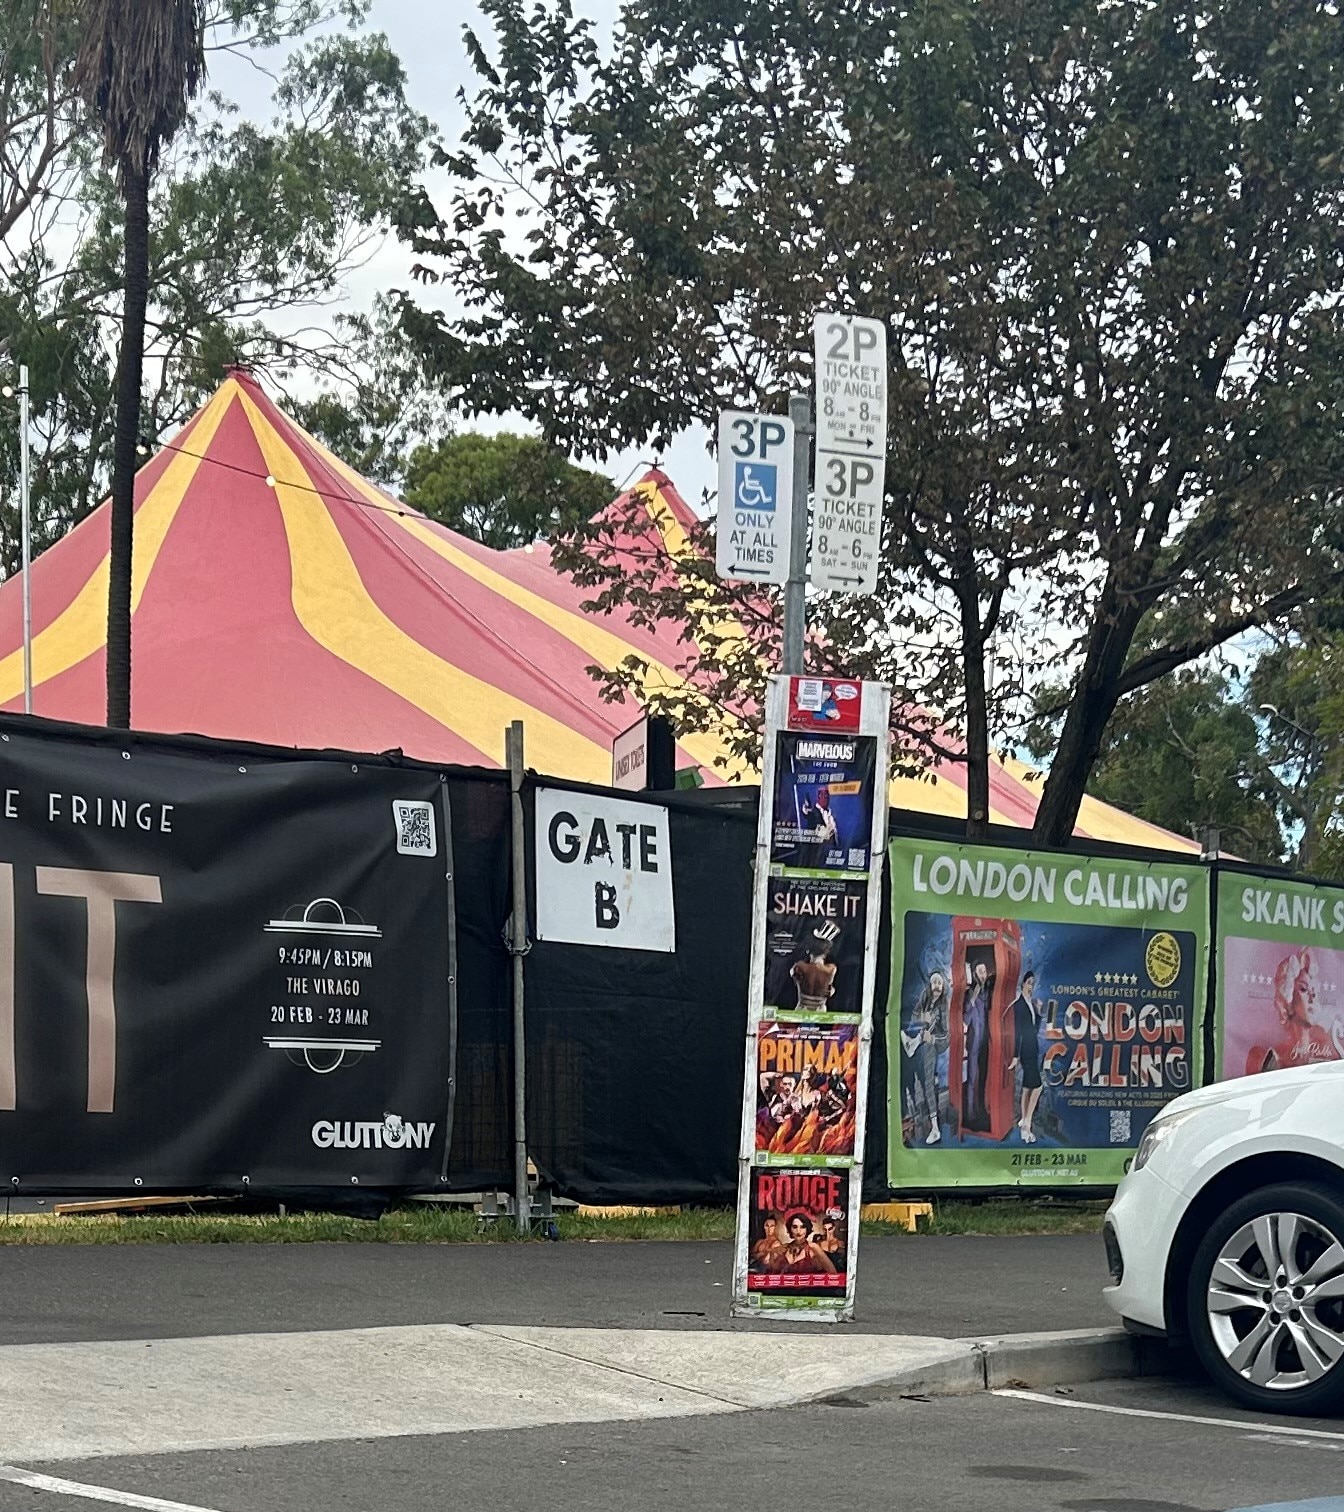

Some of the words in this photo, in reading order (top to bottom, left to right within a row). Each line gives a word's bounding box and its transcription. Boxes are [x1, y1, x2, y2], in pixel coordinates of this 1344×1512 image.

[826, 323, 878, 362] 2P
[823, 360, 879, 382] TICKET
[844, 381, 882, 400] ANGLE
[731, 419, 786, 460] 3P
[860, 423, 875, 435] FRI
[825, 459, 874, 499] 3P
[822, 499, 876, 518] TICKET
[735, 512, 775, 529] ONLY
[838, 517, 876, 536] ANGLE
[730, 530, 747, 544] AT
[752, 532, 778, 548] ALL
[734, 546, 774, 564] TIMES
[820, 557, 837, 568] SAT
[851, 561, 868, 572] SUN
[798, 742, 853, 760] MARVELOUS
[48, 792, 174, 834] FRINGE
[548, 810, 659, 874] GATE
[912, 854, 1057, 904] LONDON
[1063, 869, 1188, 914] CALLING
[594, 880, 620, 930] B
[773, 892, 838, 917] SHAKE
[843, 895, 861, 918] IT
[1241, 887, 1326, 932] SKANK
[278, 947, 321, 965] 9:45PM
[334, 949, 373, 968] 8:15PM
[286, 976, 309, 995] THE
[313, 978, 360, 997] VIRAGO
[1097, 987, 1138, 998] GREATEST
[270, 1006, 285, 1023] 20
[289, 1006, 313, 1024] FEB
[327, 1007, 341, 1024] 23
[344, 1008, 369, 1026] MAR
[1044, 999, 1185, 1044] LONDON
[759, 1037, 857, 1075] PRIMAL
[1042, 1042, 1190, 1089] CALLING
[311, 1118, 436, 1149] GLUTTONY
[1011, 1153, 1022, 1166] 21
[1024, 1153, 1042, 1166] FEB
[1051, 1154, 1065, 1166] 23
[1066, 1153, 1087, 1166] MAR
[757, 1174, 843, 1212] ROUGE
